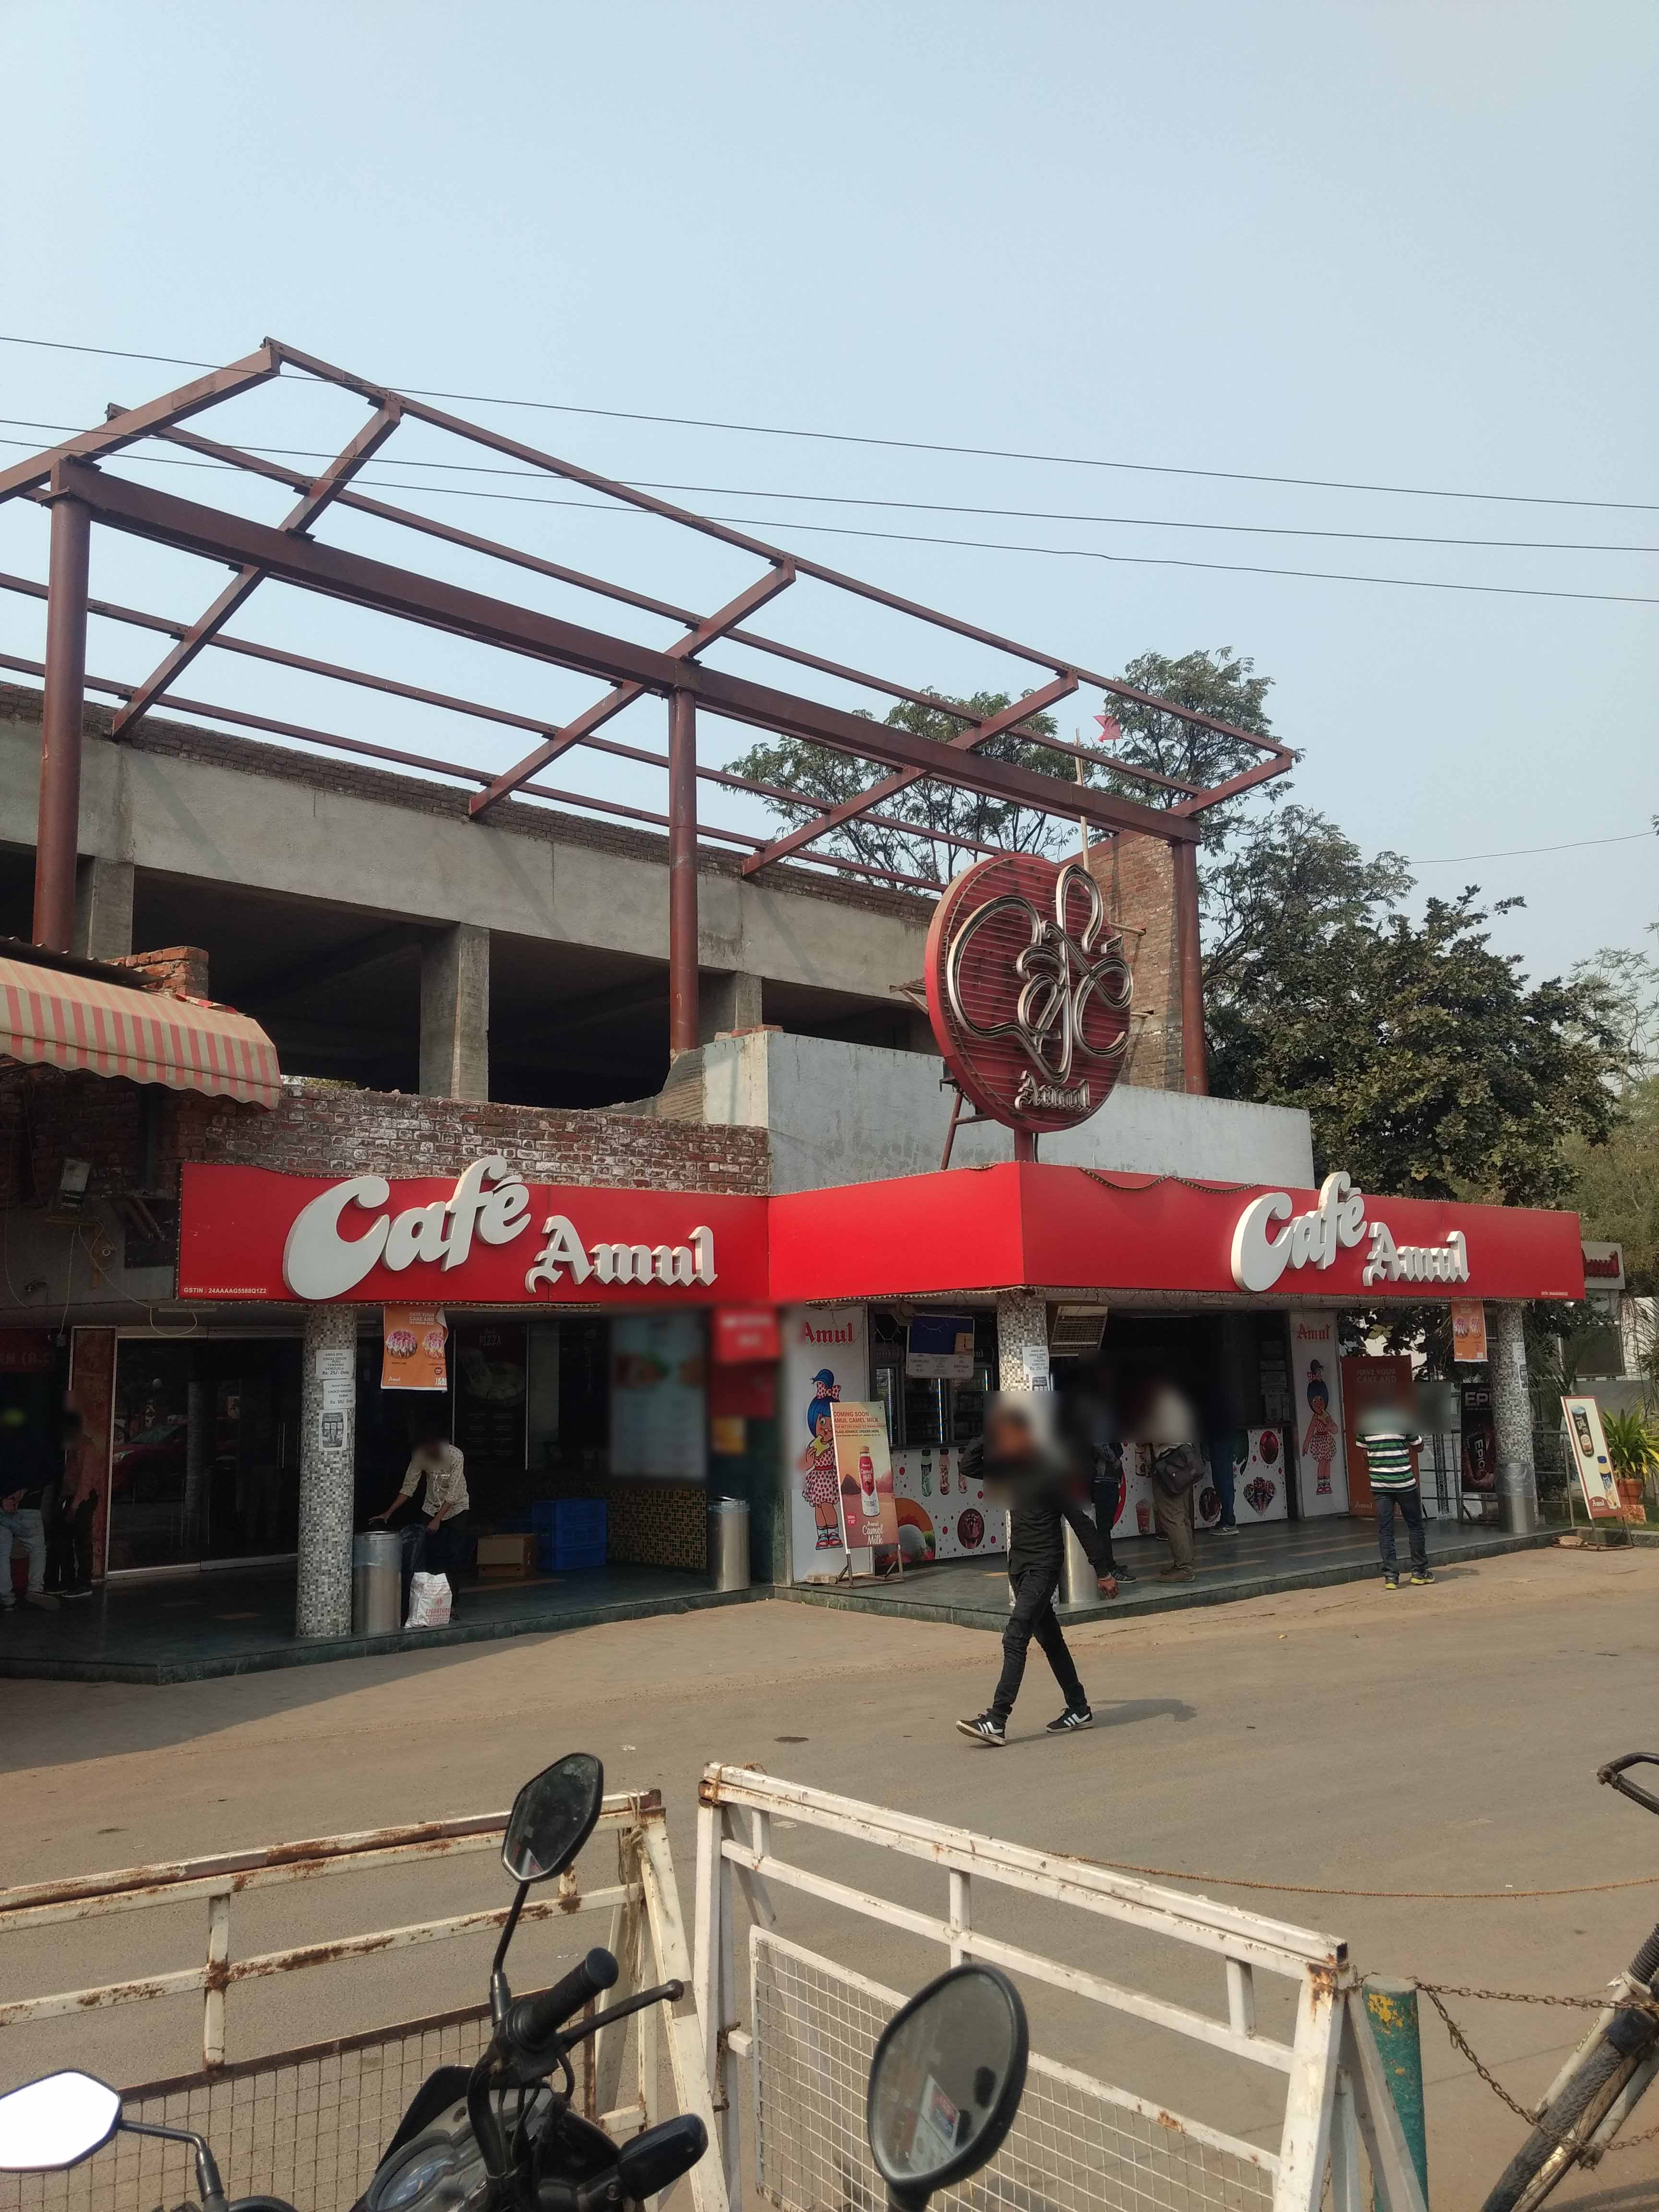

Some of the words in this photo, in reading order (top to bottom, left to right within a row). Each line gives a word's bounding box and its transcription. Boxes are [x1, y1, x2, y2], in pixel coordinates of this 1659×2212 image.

[1014, 1070, 1091, 1112] Amul
[282, 1154, 531, 1300] Café
[1231, 1171, 1367, 1291] Café
[525, 1215, 718, 1293] Amul
[1362, 1222, 1470, 1286] Amul
[1297, 1323, 1330, 1340] Amul
[1475, 1439, 1485, 1469] EPIC
[862, 1525, 883, 1535] Camel
[867, 1535, 883, 1545] Milk
